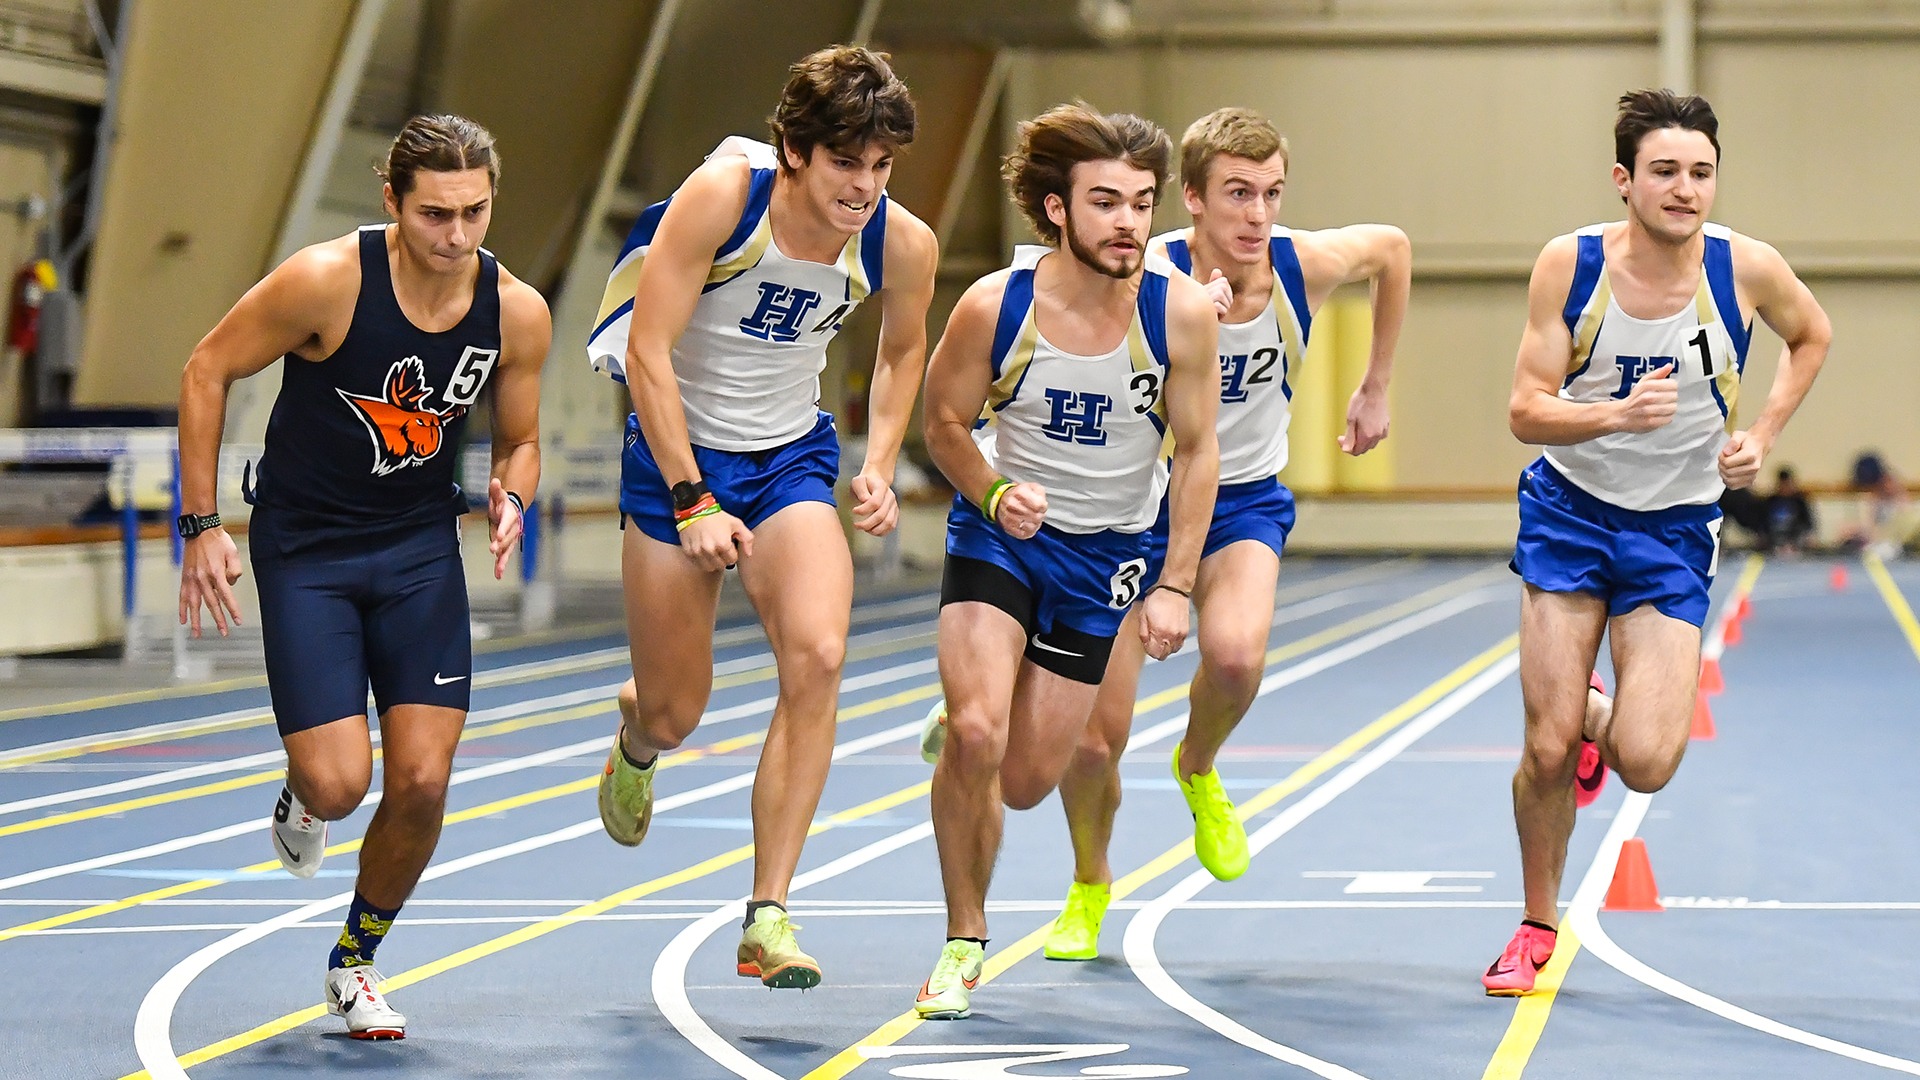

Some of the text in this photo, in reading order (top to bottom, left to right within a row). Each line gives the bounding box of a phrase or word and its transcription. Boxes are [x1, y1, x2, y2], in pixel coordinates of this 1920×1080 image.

[739, 281, 821, 343] H
[811, 303, 850, 335] 4
[452, 351, 491, 400] 5
[1246, 347, 1279, 385] 2
[1688, 328, 1713, 377] 1
[1041, 387, 1113, 446] H
[1130, 373, 1159, 415] 3
[1115, 564, 1140, 607] 3
